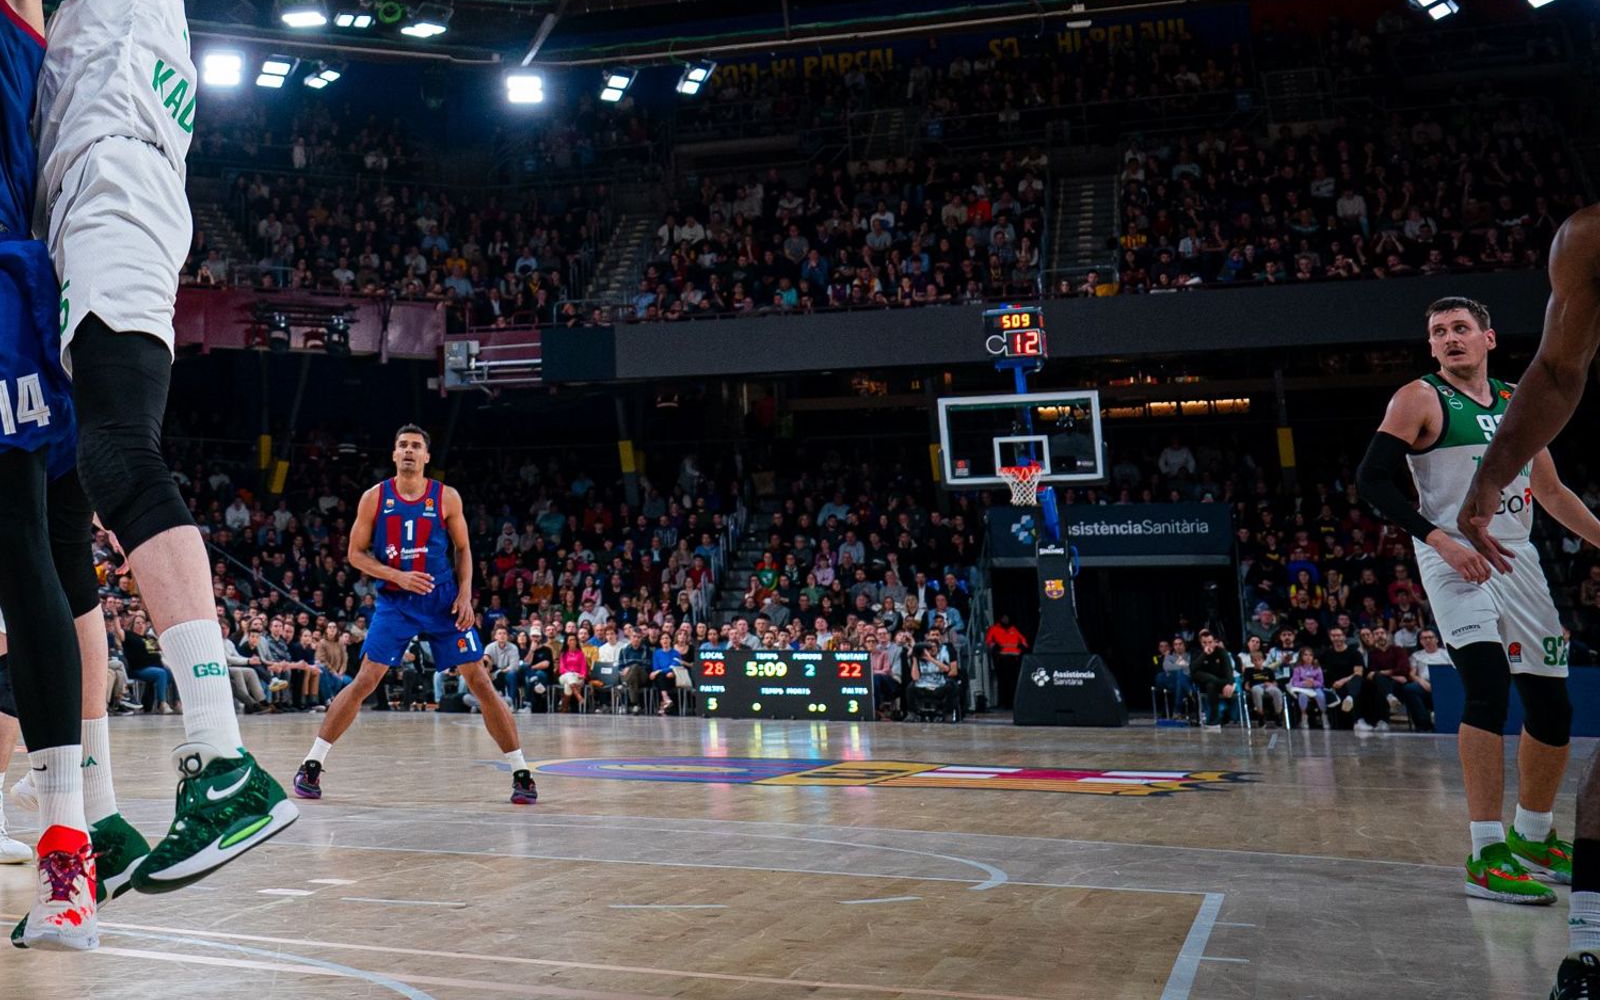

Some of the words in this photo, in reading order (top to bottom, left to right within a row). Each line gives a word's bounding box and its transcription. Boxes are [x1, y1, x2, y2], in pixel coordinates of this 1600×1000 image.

[1017, 332, 1038, 353] 12
[405, 520, 413, 540] 1
[466, 631, 476, 652] 1
[1543, 636, 1568, 665] 92
[704, 661, 725, 675] 28
[746, 661, 787, 676] 5:09
[805, 664, 815, 676] 2
[839, 662, 861, 676] 22
[1053, 670, 1095, 679] Assistència
[708, 698, 717, 710] 5
[848, 700, 858, 712] 3
